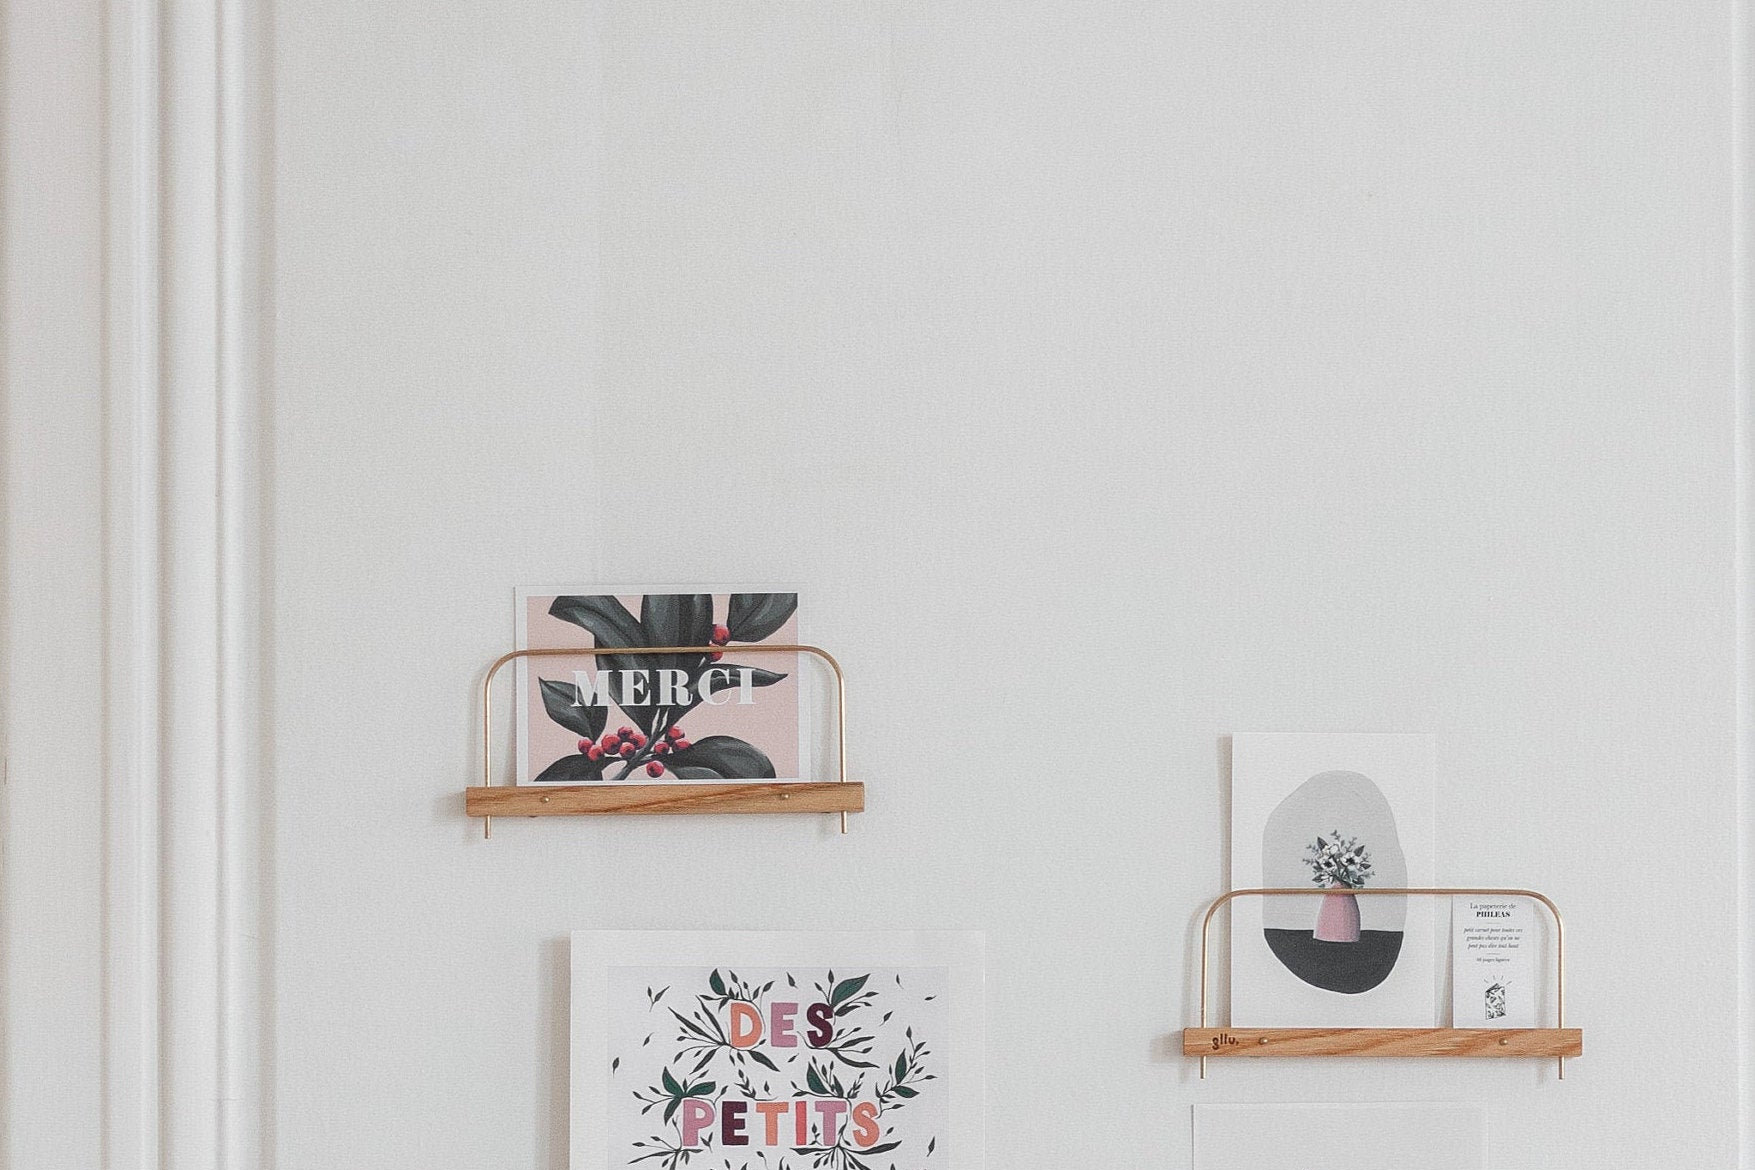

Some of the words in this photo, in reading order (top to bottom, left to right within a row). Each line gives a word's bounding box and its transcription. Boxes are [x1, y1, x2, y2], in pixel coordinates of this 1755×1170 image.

[570, 667, 757, 708] MERCI
[729, 1001, 836, 1048] DES
[682, 1097, 880, 1148] PETITS
